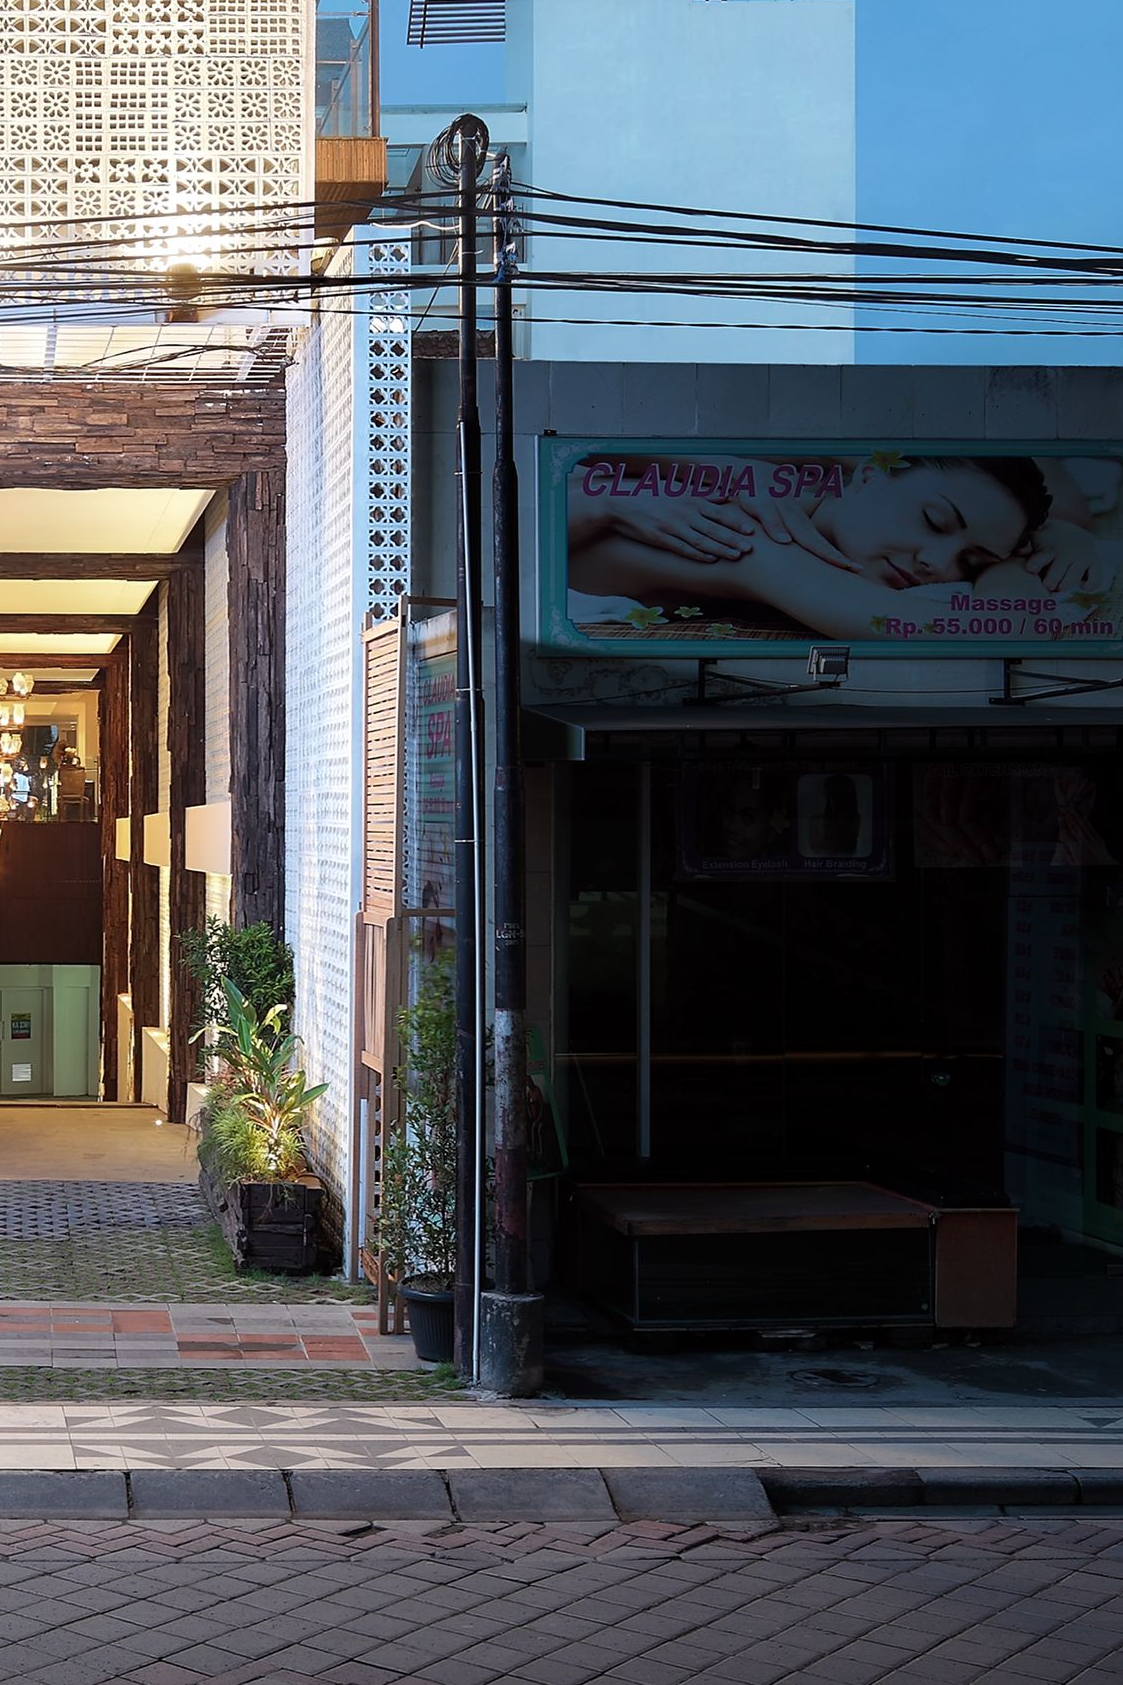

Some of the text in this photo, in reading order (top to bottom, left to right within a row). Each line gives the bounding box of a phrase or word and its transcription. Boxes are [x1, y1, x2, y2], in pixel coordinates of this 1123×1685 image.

[581, 461, 845, 499] CLAUDIA SPA
[950, 594, 1057, 615] Massage
[885, 617, 923, 638] Rp.
[932, 617, 1013, 635] 55.000
[1033, 617, 1062, 635] 60
[1070, 617, 1114, 635] min
[426, 710, 452, 760] SPA
